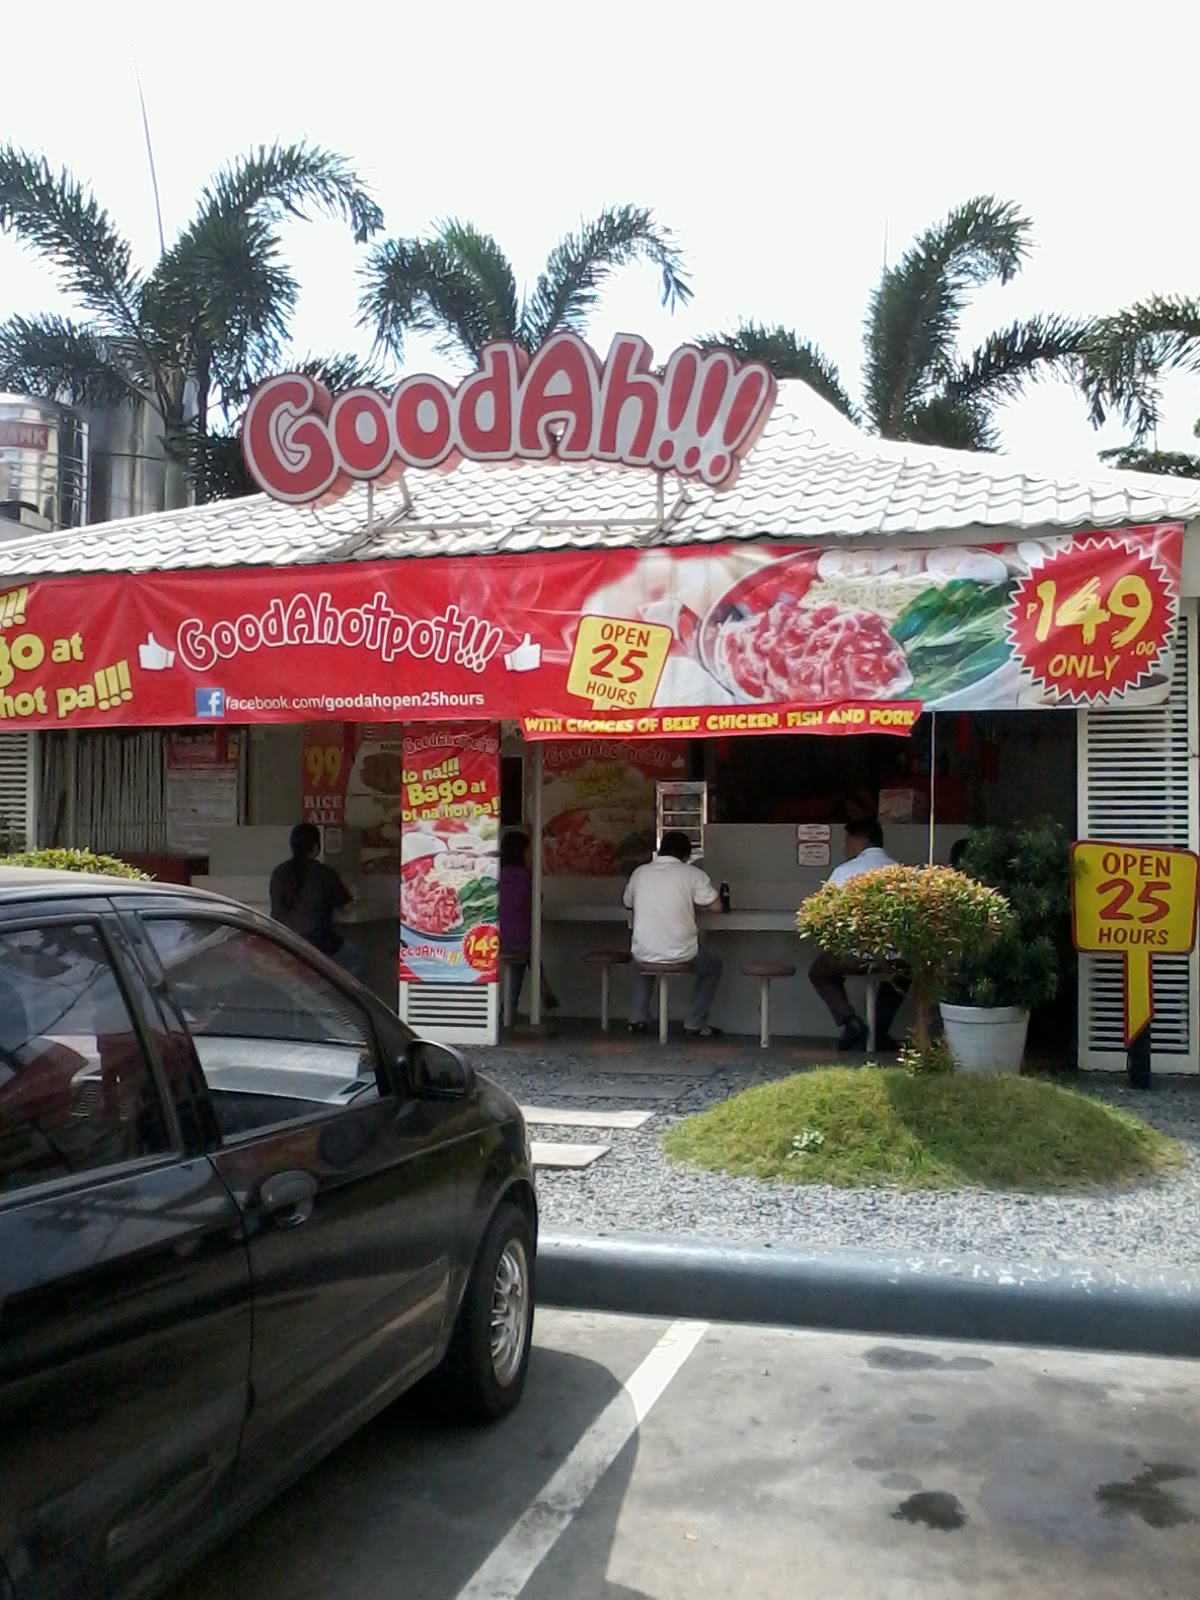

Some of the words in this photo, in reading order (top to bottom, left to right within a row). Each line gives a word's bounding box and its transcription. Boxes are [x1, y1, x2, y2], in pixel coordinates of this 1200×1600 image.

[243, 332, 774, 503] GoodAh!!!
[177, 591, 503, 674] GoodAhotpot!!!
[601, 623, 651, 648] OPEN
[51, 631, 84, 663] at
[590, 643, 648, 684] 25
[1048, 654, 1120, 681] ONLY
[56, 659, 134, 719] pa!!!
[224, 690, 485, 711] facebook.com/goodahopen25hours
[586, 681, 637, 706] HOURS
[524, 717, 562, 732] WITH
[566, 718, 634, 733] CHOICES
[637, 717, 658, 732] OF
[786, 710, 824, 728] FISH
[827, 709, 866, 725] AND
[869, 709, 915, 725] PORK
[407, 779, 468, 806] Bago
[1102, 852, 1171, 878] OPEN
[1096, 878, 1172, 924] 25
[1098, 927, 1169, 945] HOURS
